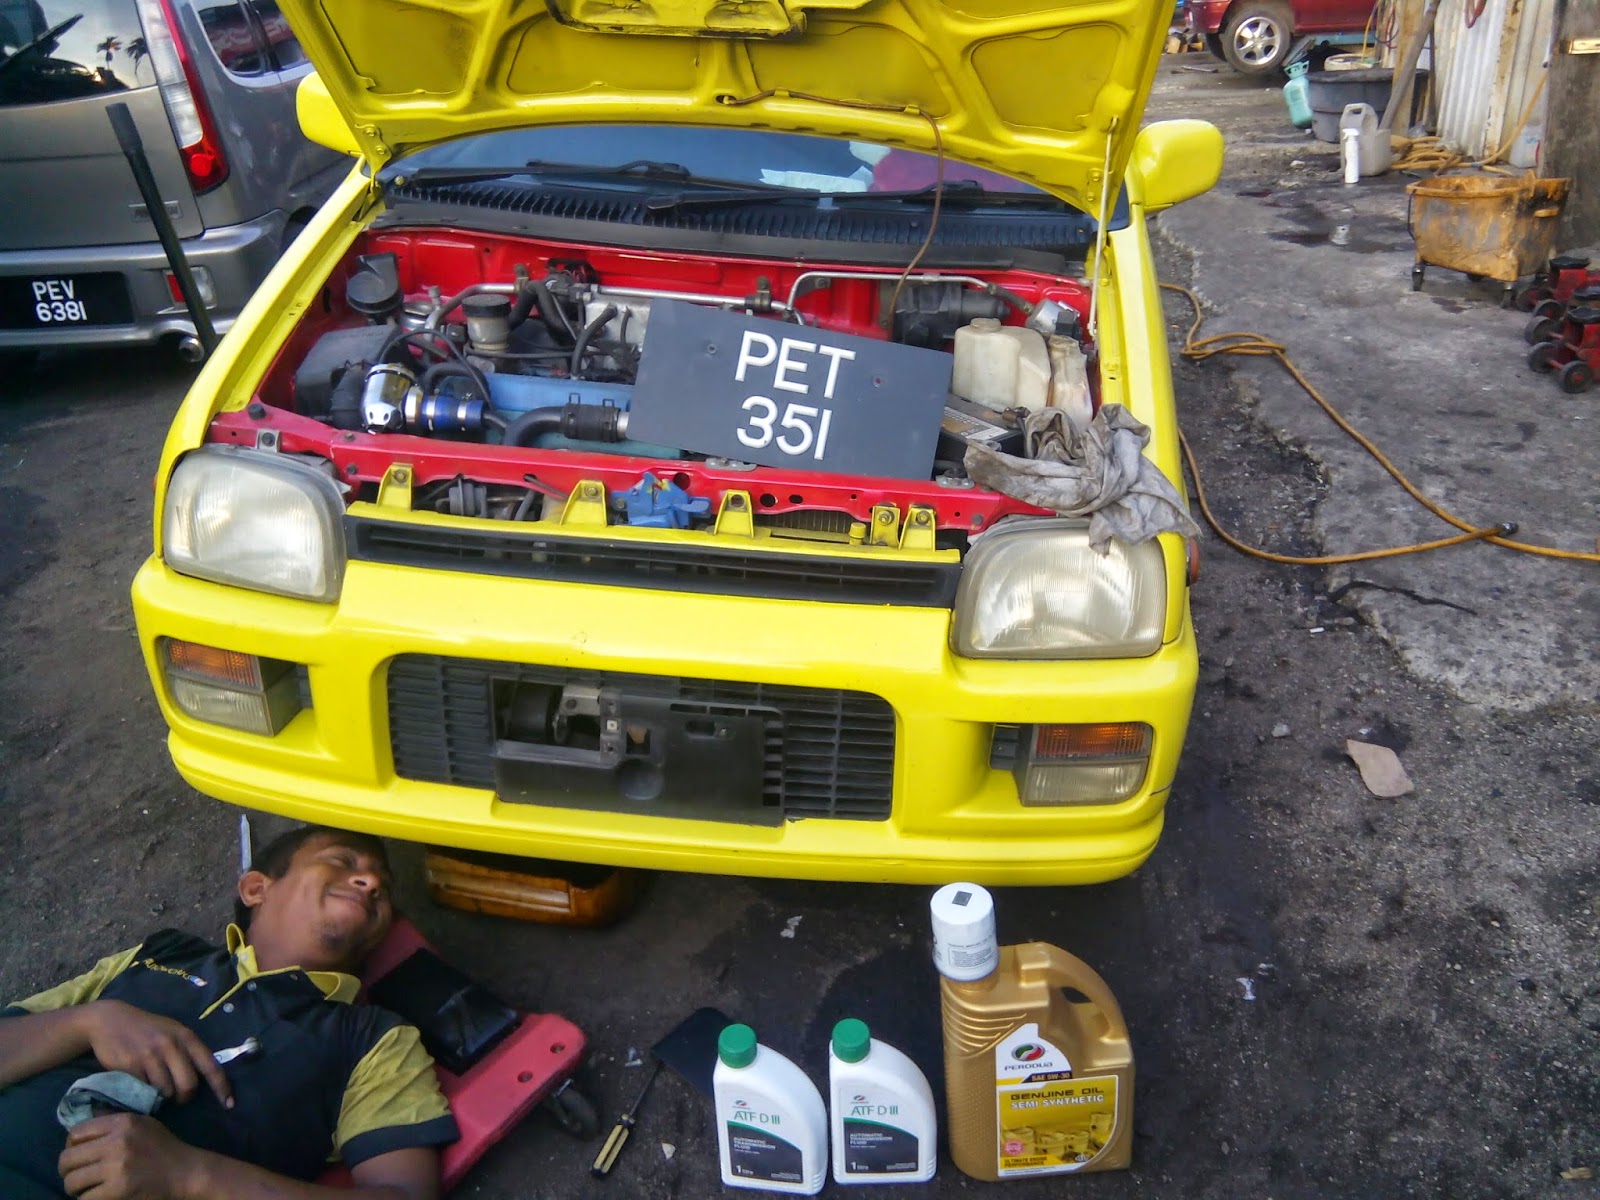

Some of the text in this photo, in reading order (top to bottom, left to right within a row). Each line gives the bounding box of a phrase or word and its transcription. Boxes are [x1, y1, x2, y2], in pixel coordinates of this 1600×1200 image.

[32, 279, 75, 301] PEV
[36, 300, 88, 322] 6381
[734, 330, 856, 399] PET
[736, 395, 832, 460] 351
[1004, 1062, 1053, 1071] PERODUA
[1047, 1072, 1070, 1080] 5W-30
[1010, 1087, 1104, 1101] GENUINE OIL
[1012, 1094, 1104, 1109] SEMI SYNTHETIC
[733, 1110, 781, 1125] ATF D III
[850, 1105, 899, 1116] ATF D III
[736, 1165, 741, 1174] 1
[850, 1161, 856, 1170] 1
